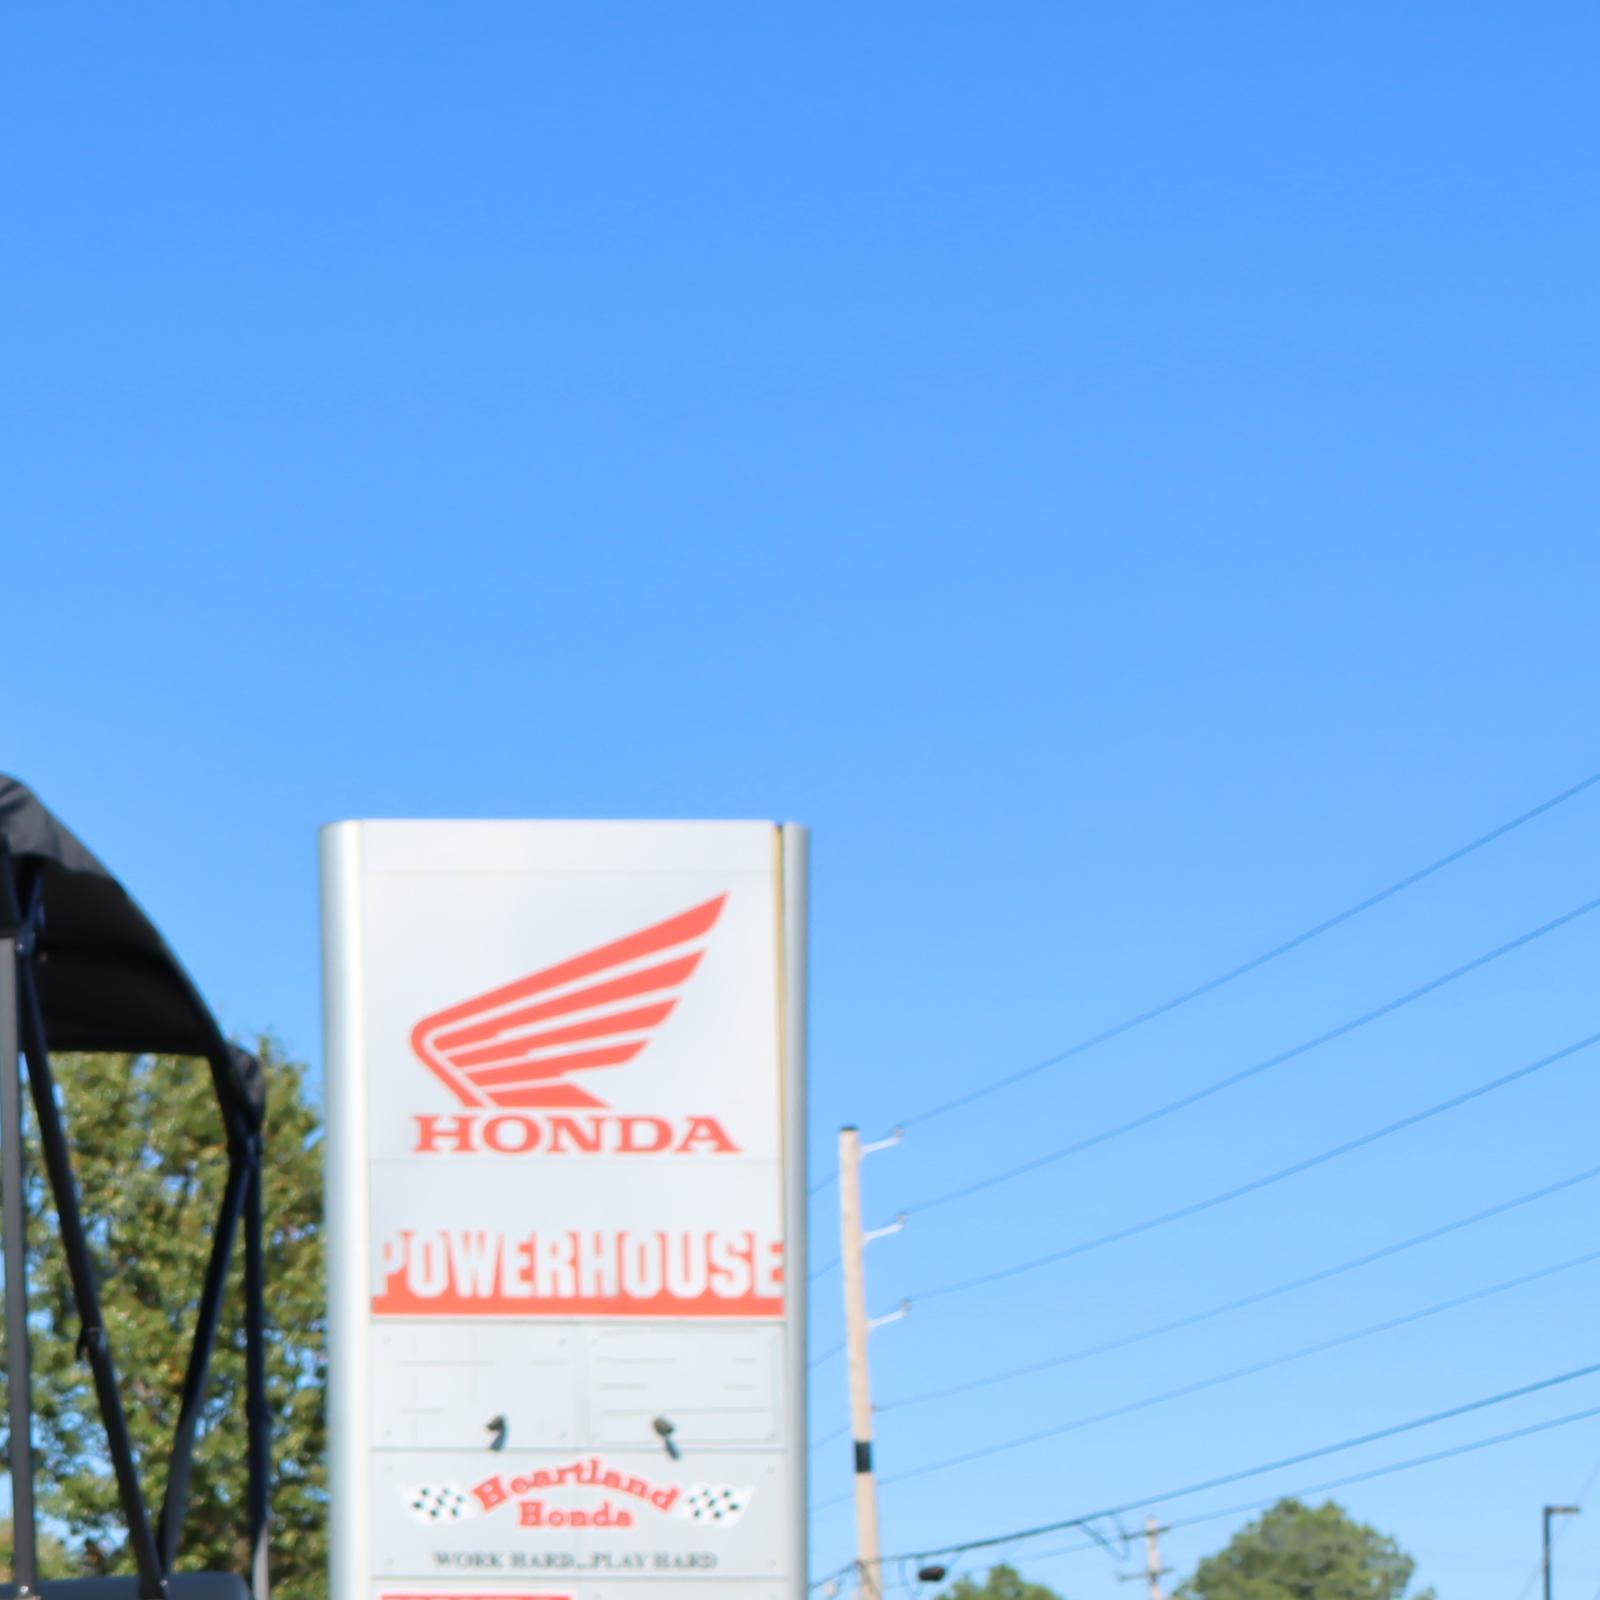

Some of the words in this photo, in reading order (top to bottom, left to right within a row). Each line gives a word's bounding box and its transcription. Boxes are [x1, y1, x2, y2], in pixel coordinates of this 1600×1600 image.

[411, 1115, 742, 1153] HONDA
[374, 1231, 786, 1298] POWERHOUSE
[472, 1457, 680, 1512] Heartland
[518, 1501, 633, 1528] Honda
[433, 1551, 504, 1570] WORK
[653, 1551, 718, 1570] HARD
